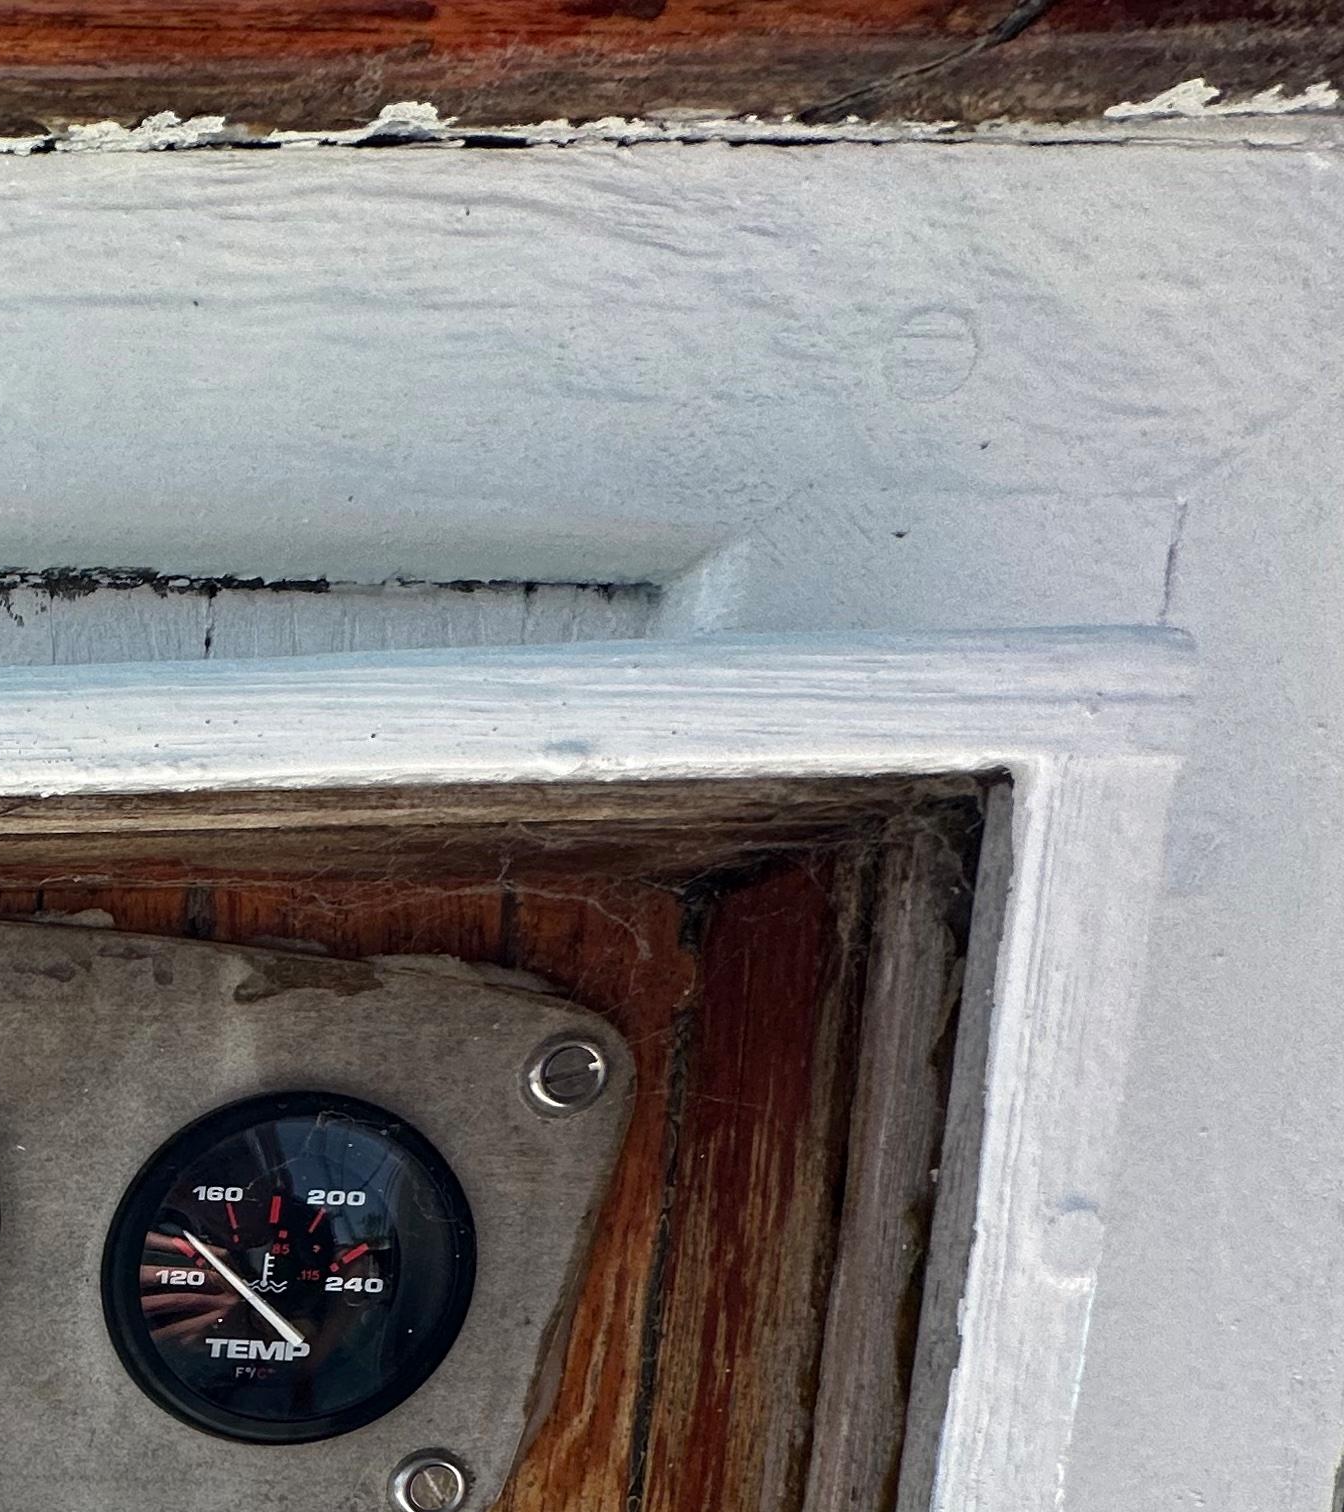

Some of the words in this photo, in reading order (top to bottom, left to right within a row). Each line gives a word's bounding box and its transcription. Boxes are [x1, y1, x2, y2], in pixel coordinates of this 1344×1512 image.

[192, 1185, 243, 1202] 160
[306, 1189, 367, 1206] 200
[155, 1270, 205, 1286] 120
[324, 1276, 384, 1294] 240
[205, 1338, 310, 1361] TEMP
